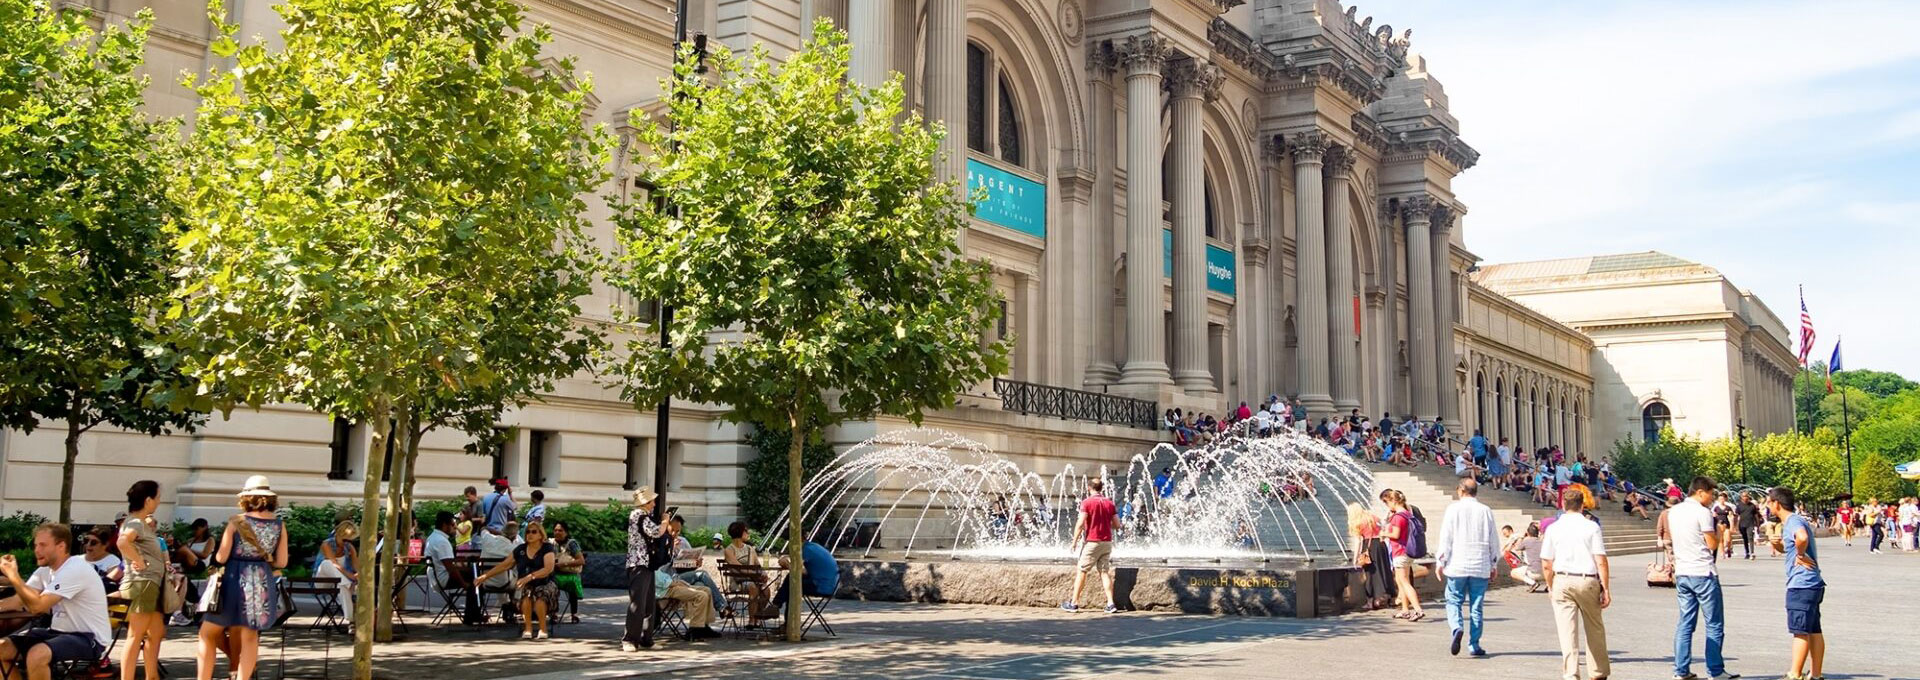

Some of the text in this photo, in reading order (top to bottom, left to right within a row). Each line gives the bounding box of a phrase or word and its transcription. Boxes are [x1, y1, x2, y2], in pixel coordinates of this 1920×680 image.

[1208, 261, 1232, 280] Huyghe
[1190, 576, 1290, 588] David H. Koch Plaza
